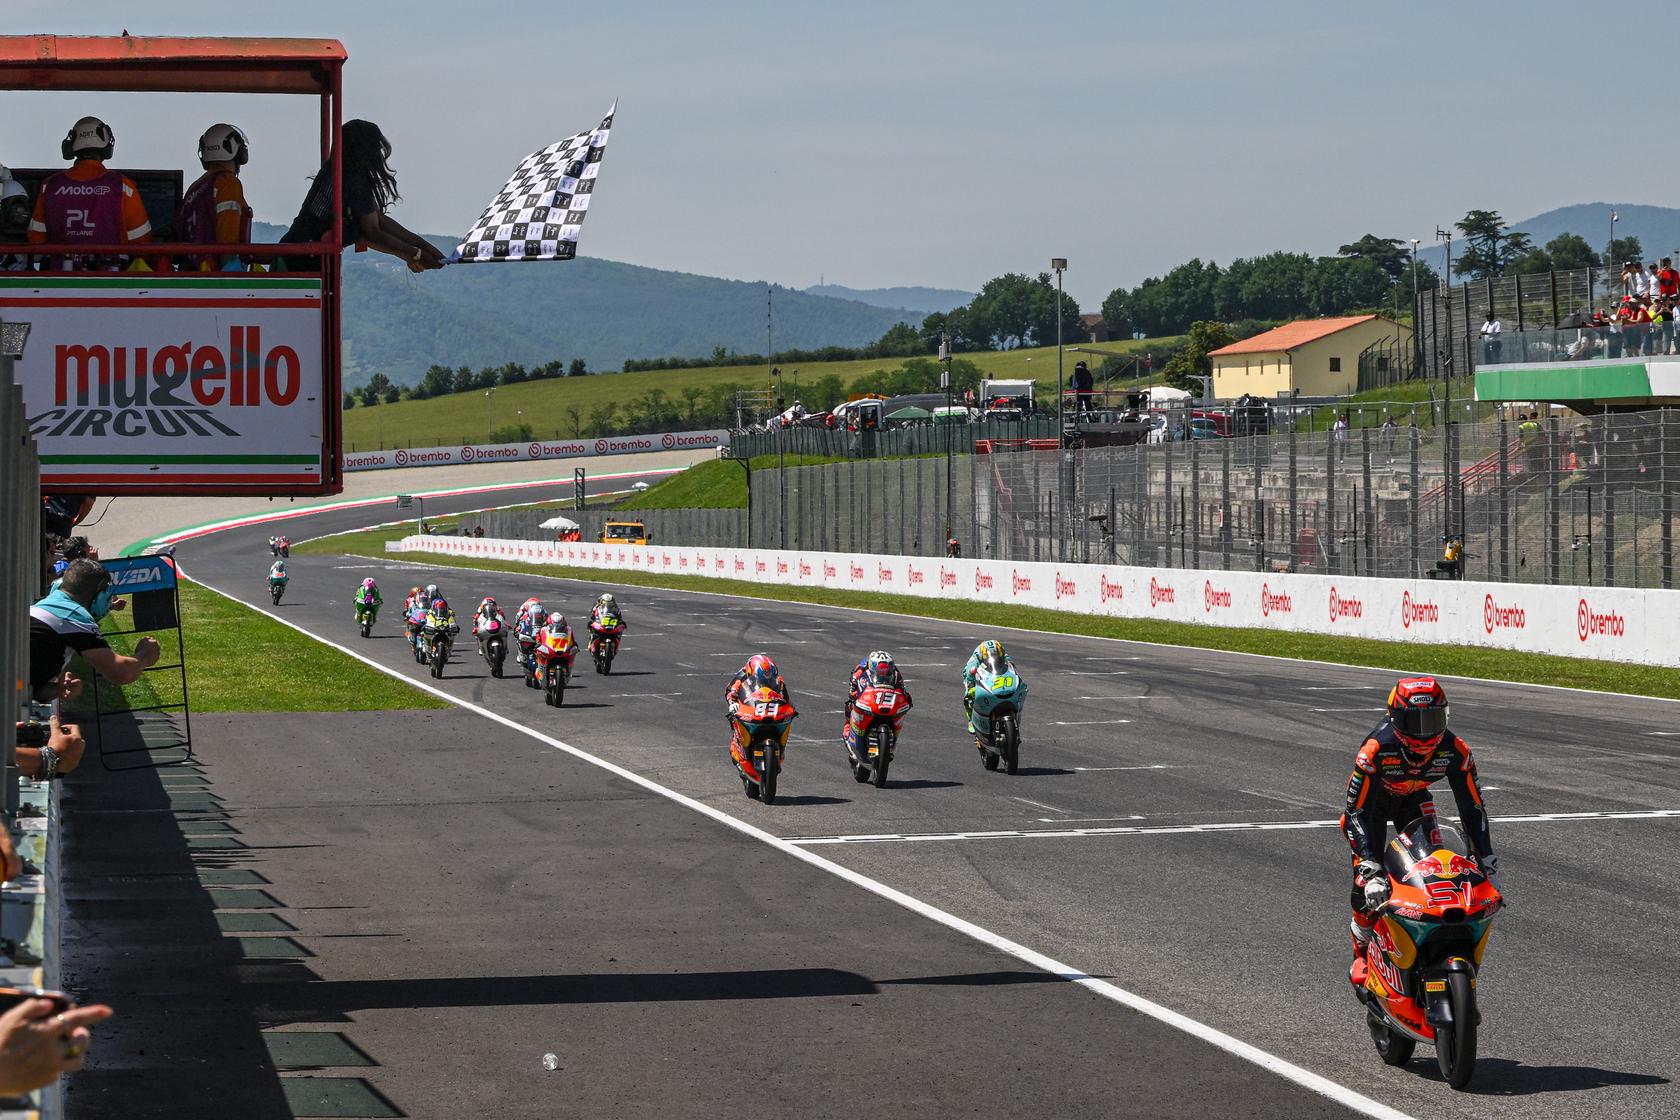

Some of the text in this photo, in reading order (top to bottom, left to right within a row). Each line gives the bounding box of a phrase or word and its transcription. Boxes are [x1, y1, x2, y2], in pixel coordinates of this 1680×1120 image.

[66, 209, 96, 228] PL
[55, 326, 301, 408] mugello
[28, 409, 241, 437] CIRCUIT
[543, 443, 585, 455] brembo
[609, 439, 652, 451] brembo
[677, 434, 719, 446] brembo
[346, 455, 386, 467] brembo
[409, 450, 451, 463] brembo
[476, 447, 519, 458] brembo
[1106, 580, 1123, 599] brembo
[1156, 583, 1175, 603] brembo
[1211, 585, 1231, 608] brembo
[1269, 587, 1292, 612] brembo
[1338, 593, 1362, 618] brembo
[1411, 598, 1439, 623] brembo
[1495, 602, 1526, 629] brembo
[1590, 608, 1625, 637] brembo
[991, 676, 1012, 690] 31
[875, 692, 896, 704] 13
[1424, 881, 1474, 908] 51
